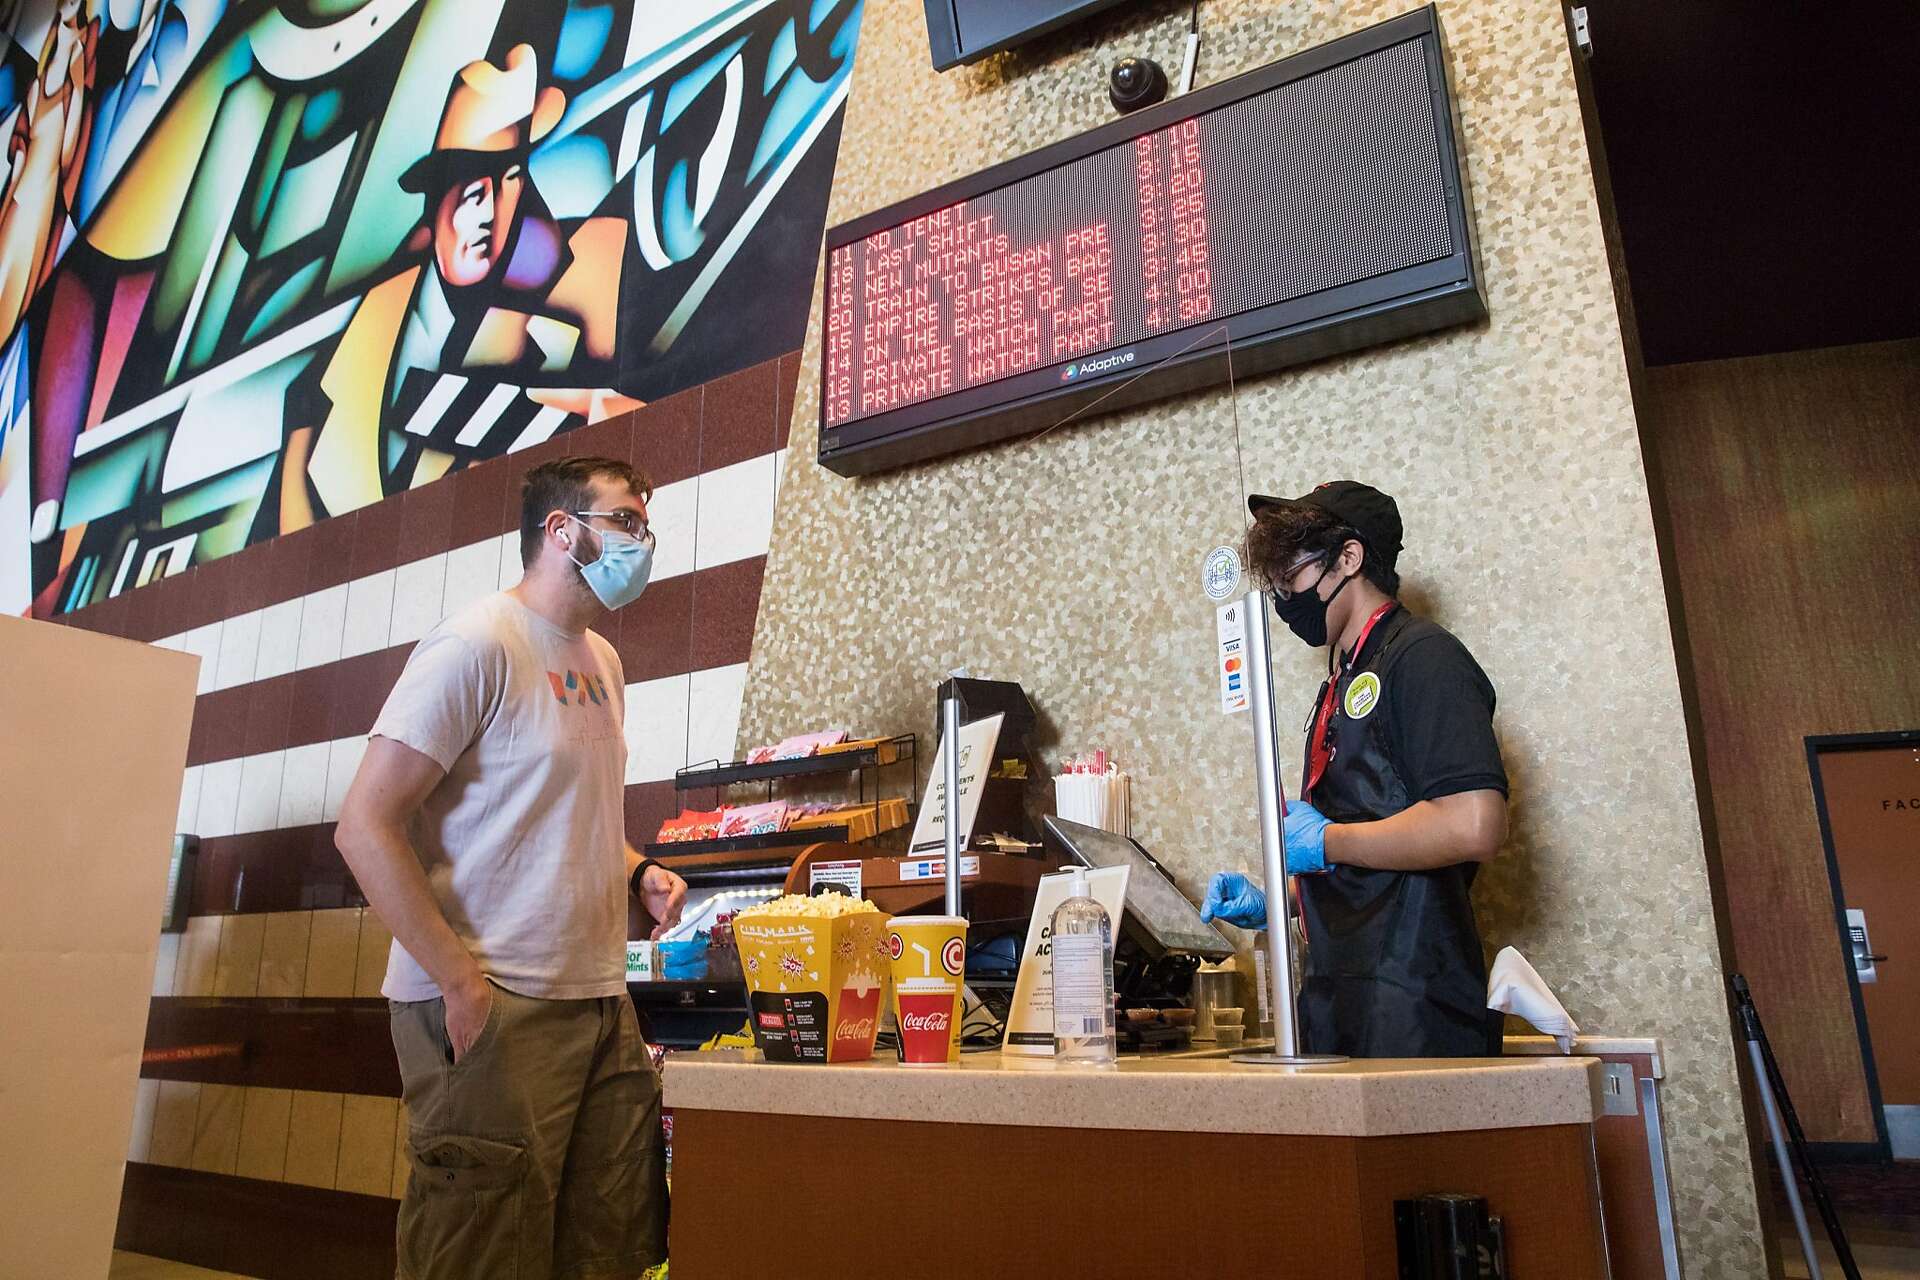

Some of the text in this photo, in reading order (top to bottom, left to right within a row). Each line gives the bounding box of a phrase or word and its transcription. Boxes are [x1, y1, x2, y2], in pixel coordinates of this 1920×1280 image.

[832, 267, 853, 288] 18
[866, 242, 915, 277] LAST
[929, 215, 994, 254] SHIFT
[833, 245, 852, 267] 11
[903, 202, 967, 240] TENET
[866, 270, 902, 299] NEW
[915, 233, 1008, 282] MUTANTS
[829, 310, 852, 332] 20
[866, 284, 928, 319] TRAIN
[941, 271, 967, 294] TO
[982, 242, 1051, 281] BUSAN
[1066, 223, 1107, 253] PRE
[829, 331, 852, 353] 15
[865, 303, 938, 342] EMPIRE
[955, 266, 1051, 313] STRIKES
[1067, 247, 1111, 278] BAC
[828, 353, 851, 376] 14
[864, 340, 889, 365] ON
[902, 325, 938, 353] THE
[954, 299, 1023, 337] BASIS
[1038, 286, 1065, 311] OF
[1083, 272, 1110, 297] SE
[828, 375, 850, 399] 12
[864, 344, 952, 389] PRIVATE
[967, 318, 1038, 357] WATCH
[1054, 295, 1112, 331] PART
[827, 399, 851, 422] 13
[863, 368, 952, 413] PRIVATE
[967, 342, 1039, 382] WATCH
[1054, 320, 1114, 357] PART
[1079, 352, 1135, 375] Adaptive
[1226, 643, 1240, 652] VISA
[627, 962, 649, 972] Mints
[785, 960, 802, 974] POP
[836, 1018, 873, 1041] Coca-Cola
[904, 1012, 949, 1032] Coca-Cola
